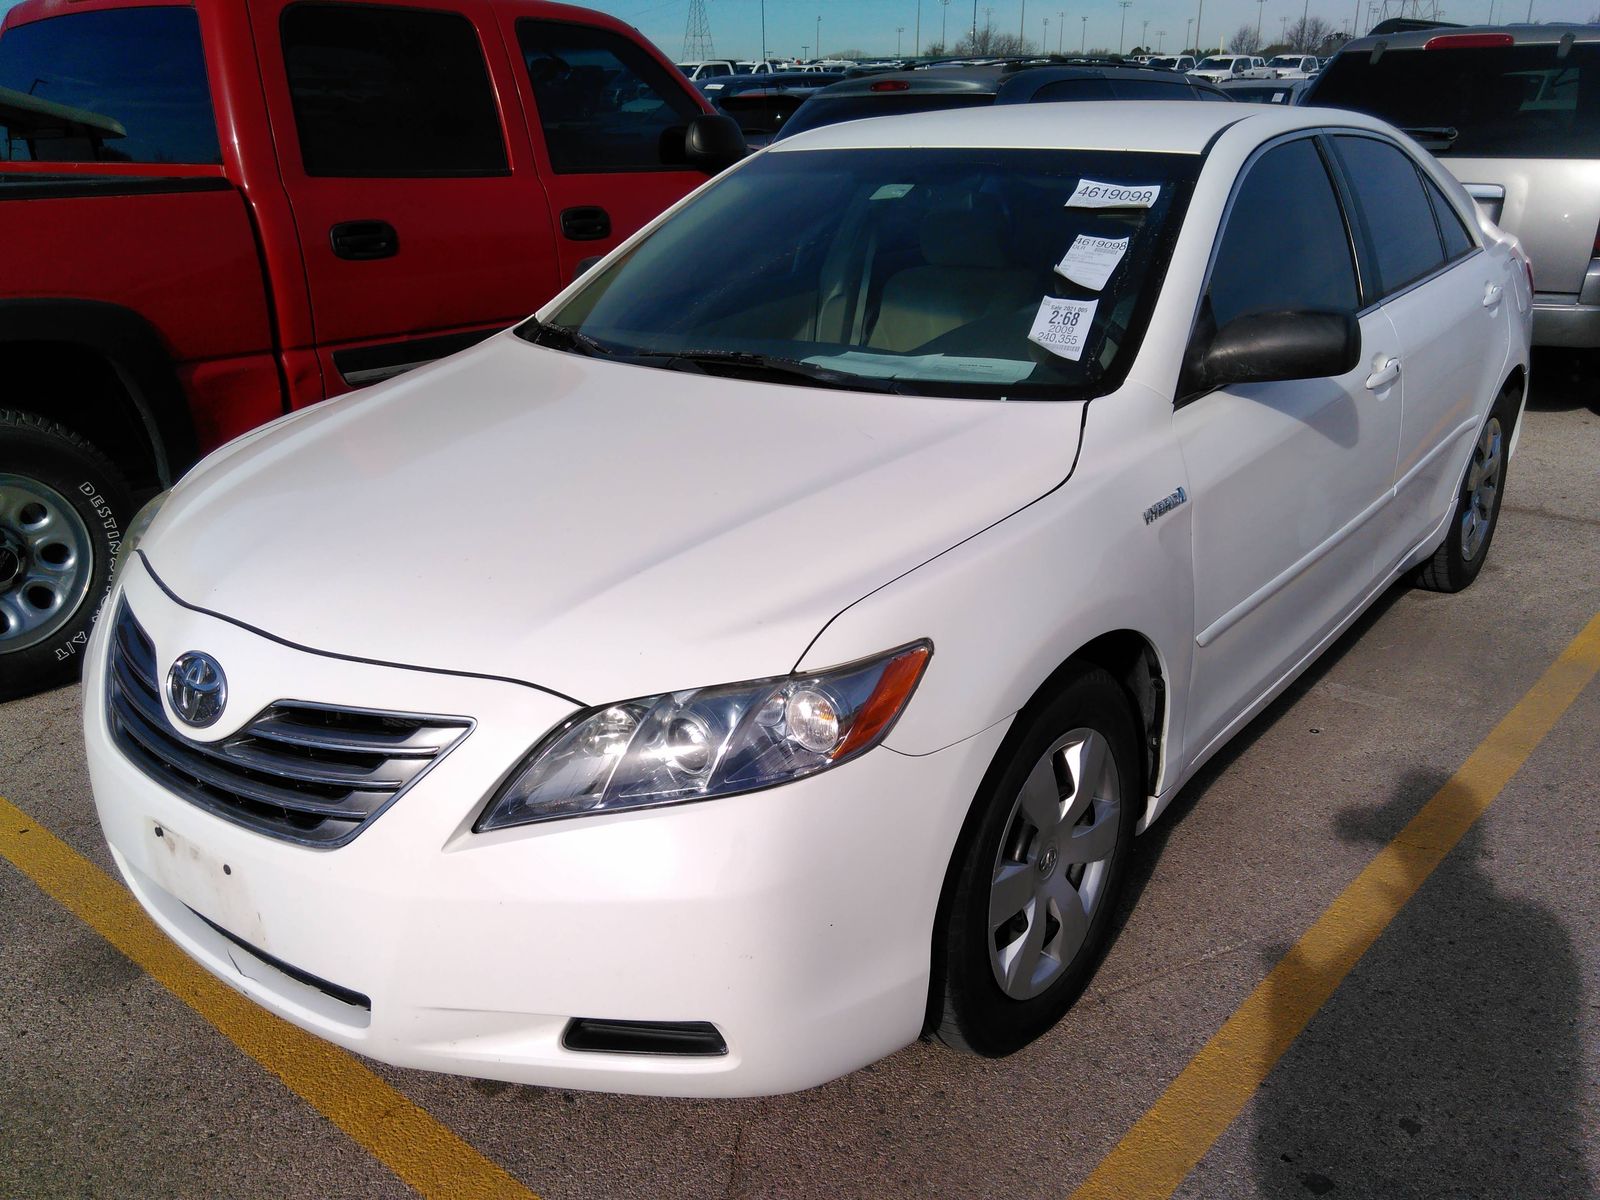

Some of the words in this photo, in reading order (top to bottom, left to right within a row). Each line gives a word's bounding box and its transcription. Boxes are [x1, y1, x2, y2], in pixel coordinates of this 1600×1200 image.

[1077, 185, 1153, 203] 4619098
[1075, 238, 1127, 251] 4619098
[1048, 310, 1080, 326] 2:68
[1048, 325, 1075, 335] 2009
[1144, 486, 1187, 525] HYBRID
[54, 631, 88, 661] A/T
